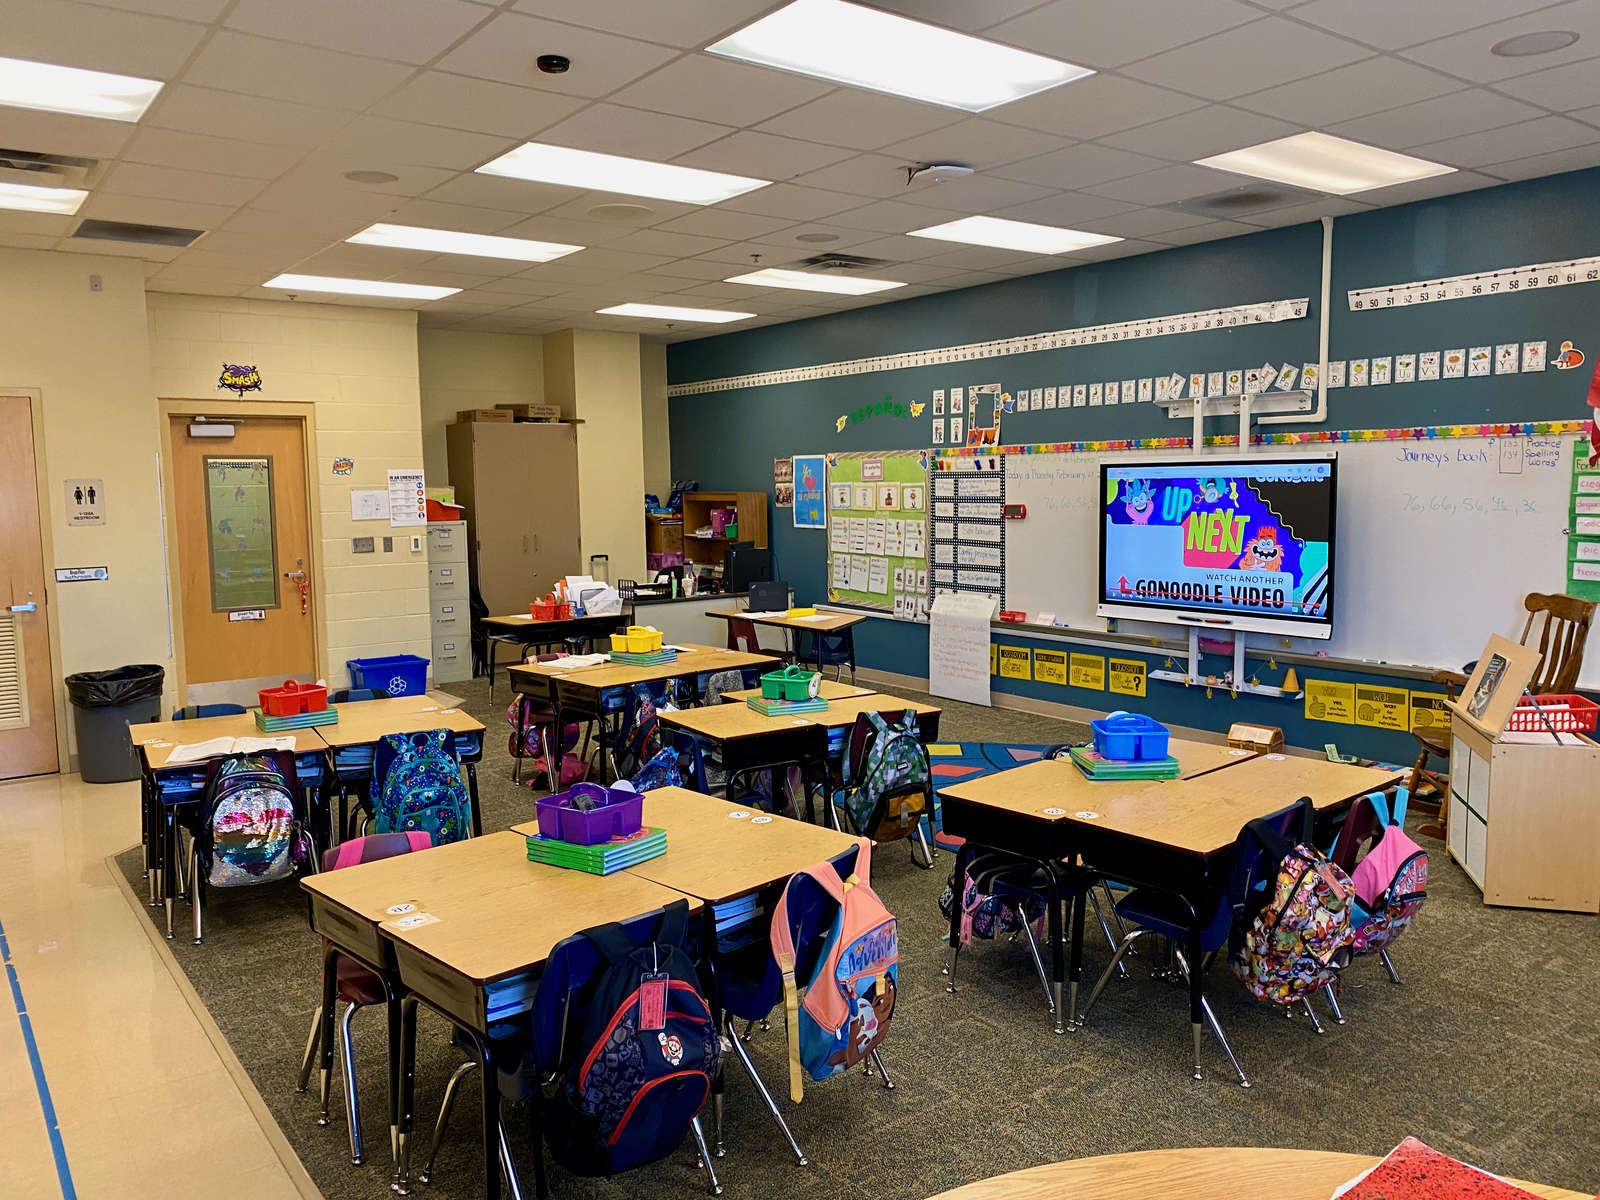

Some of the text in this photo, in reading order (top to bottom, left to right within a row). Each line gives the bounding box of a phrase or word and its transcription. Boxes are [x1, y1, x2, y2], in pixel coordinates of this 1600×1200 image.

[1354, 300, 1363, 309] 49
[1370, 299, 1378, 308] 50
[1386, 297, 1394, 306] 51
[1420, 292, 1429, 302] 53
[1436, 290, 1446, 299] 54
[1472, 286, 1482, 294] 56
[1490, 283, 1500, 292] 57
[1509, 280, 1519, 289] 58
[1528, 278, 1538, 287] 59
[1547, 275, 1558, 284] 60
[1566, 272, 1576, 282] 61
[1586, 270, 1598, 280] 62
[1396, 448, 1450, 468] Journeys
[1163, 486, 1192, 523] UP
[1186, 508, 1250, 555] NEXT
[1135, 580, 1284, 608] GONOODLE VIDEO
[1206, 574, 1284, 585] WATCH ANOTHER
